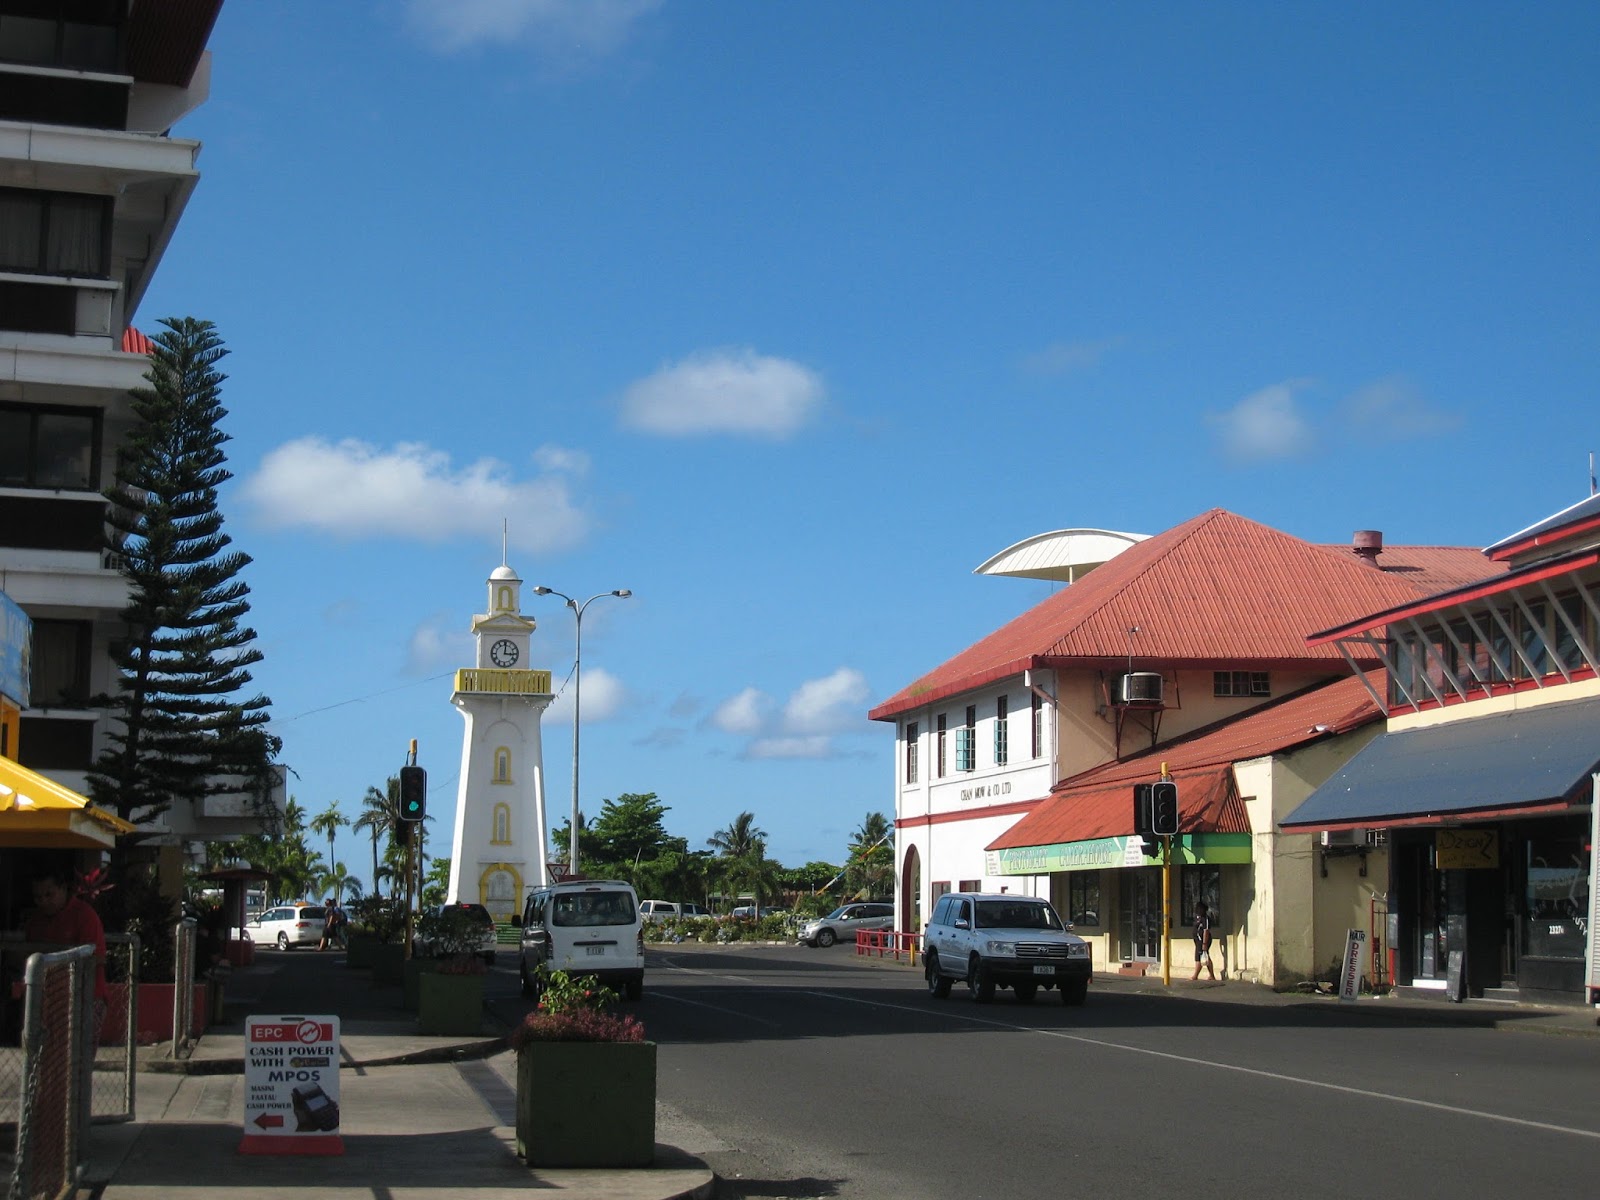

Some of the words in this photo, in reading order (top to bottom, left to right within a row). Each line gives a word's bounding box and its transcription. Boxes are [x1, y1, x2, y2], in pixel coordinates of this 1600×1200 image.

[960, 788, 973, 801] CHAN
[992, 783, 1000, 796] CO
[1001, 781, 1012, 795] LTD
[1349, 930, 1366, 942] HAIR
[1345, 942, 1360, 996] DRESSER
[255, 1027, 283, 1038] EPC
[249, 1046, 283, 1056] CASH
[288, 1046, 334, 1056] POWER
[251, 1058, 284, 1068] WITH
[268, 1070, 321, 1082] MPOS
